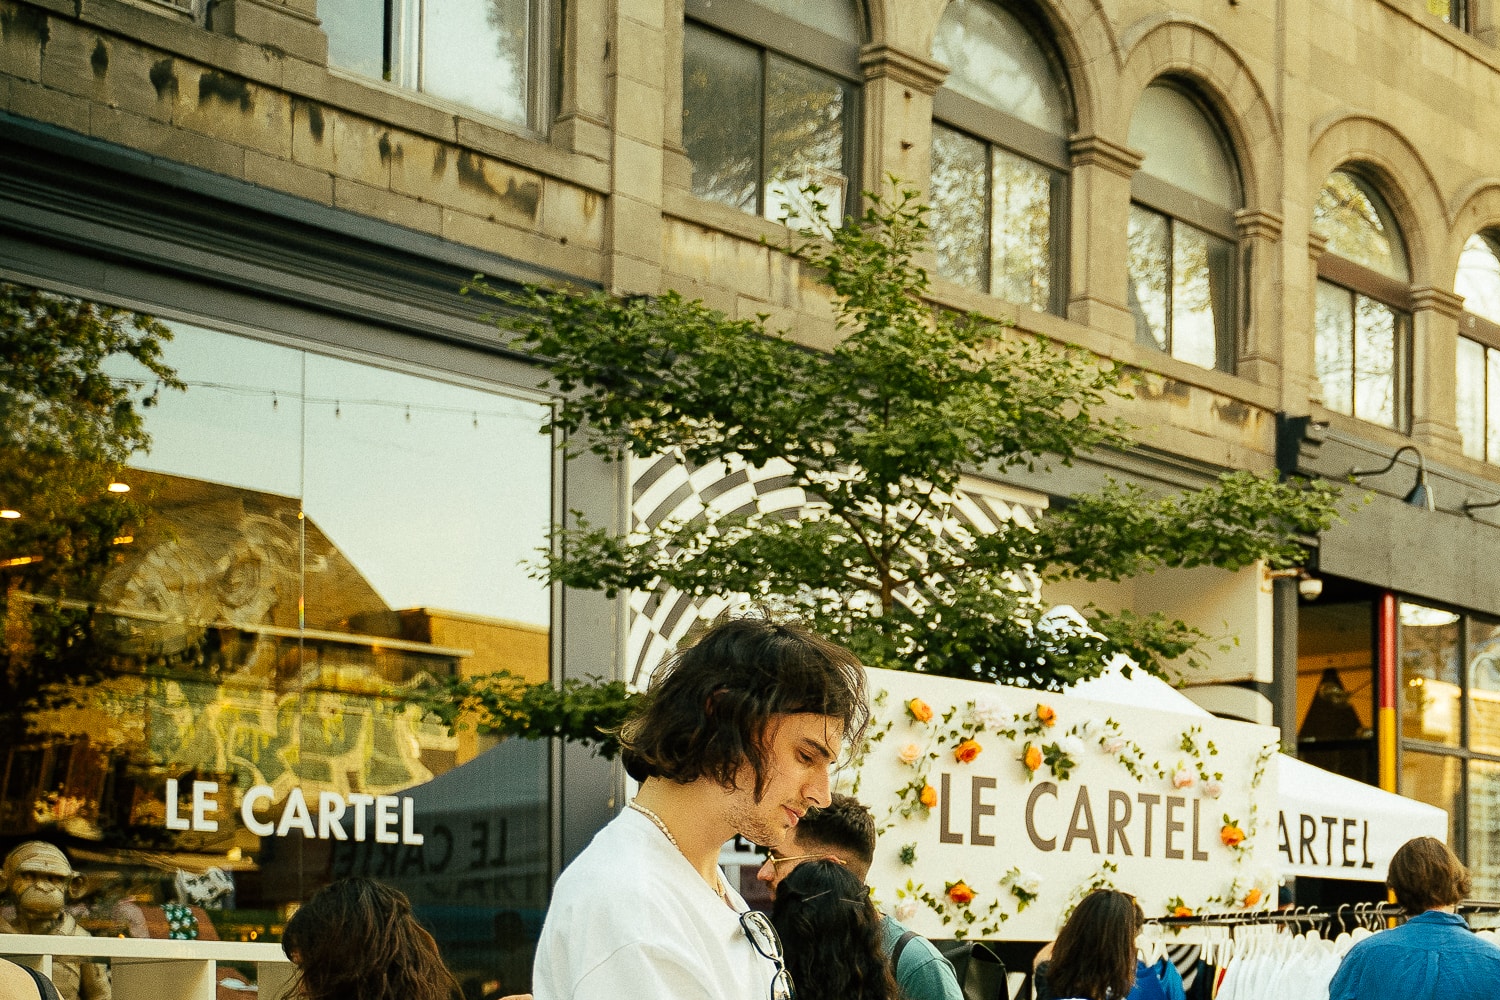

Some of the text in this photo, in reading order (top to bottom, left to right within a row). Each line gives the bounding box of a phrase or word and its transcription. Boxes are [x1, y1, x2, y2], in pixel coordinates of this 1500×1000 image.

[165, 778, 424, 846] LE CARTEL
[940, 773, 1208, 861] LE CARTEL
[1278, 810, 1375, 869] ARTEL
